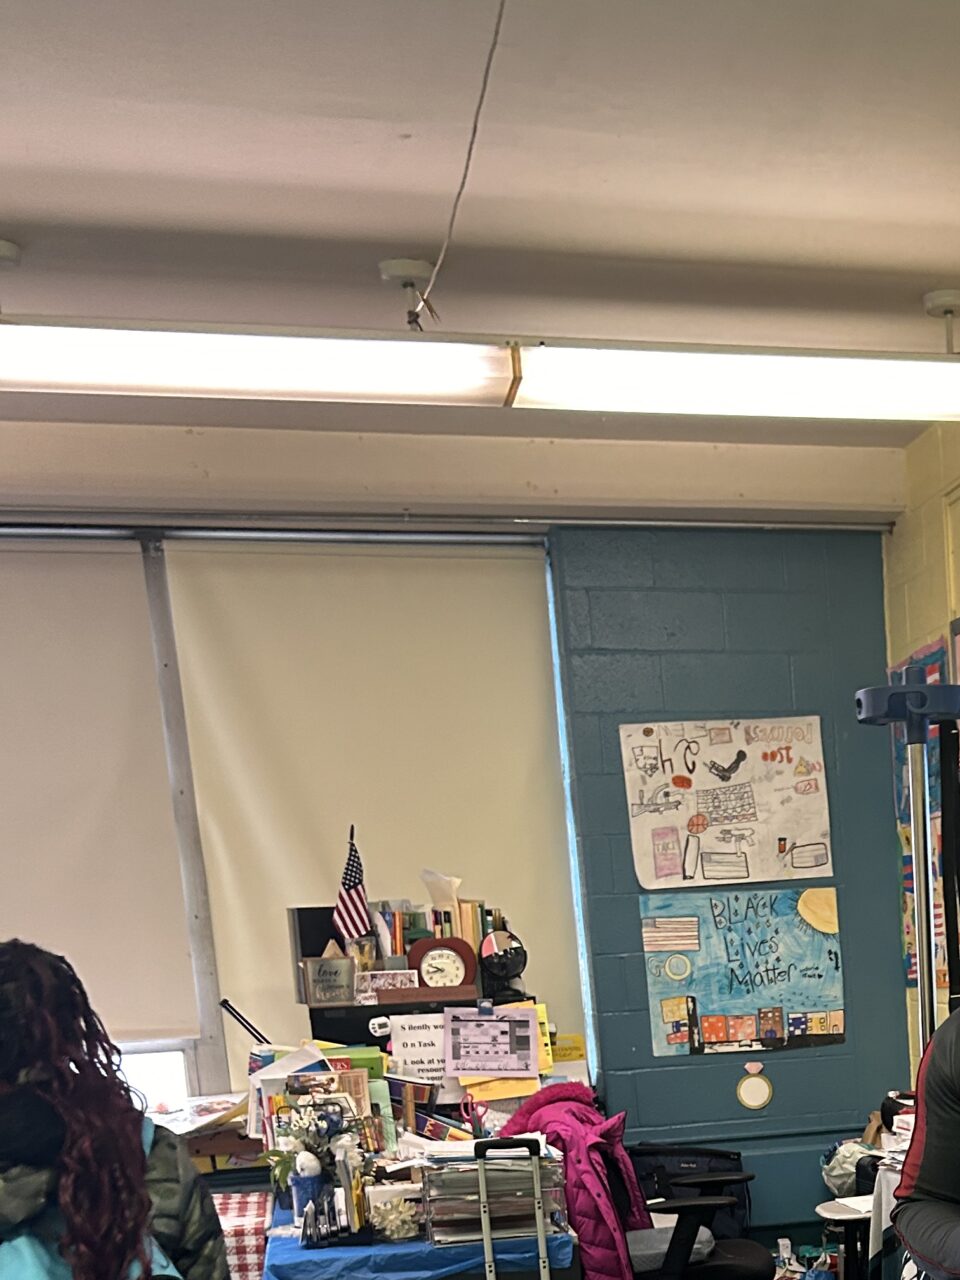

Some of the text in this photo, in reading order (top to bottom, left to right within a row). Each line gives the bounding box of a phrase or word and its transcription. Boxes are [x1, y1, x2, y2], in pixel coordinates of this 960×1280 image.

[709, 894, 779, 930] BLACK
[728, 962, 797, 995] Matter
[418, 1040, 436, 1048] Task
